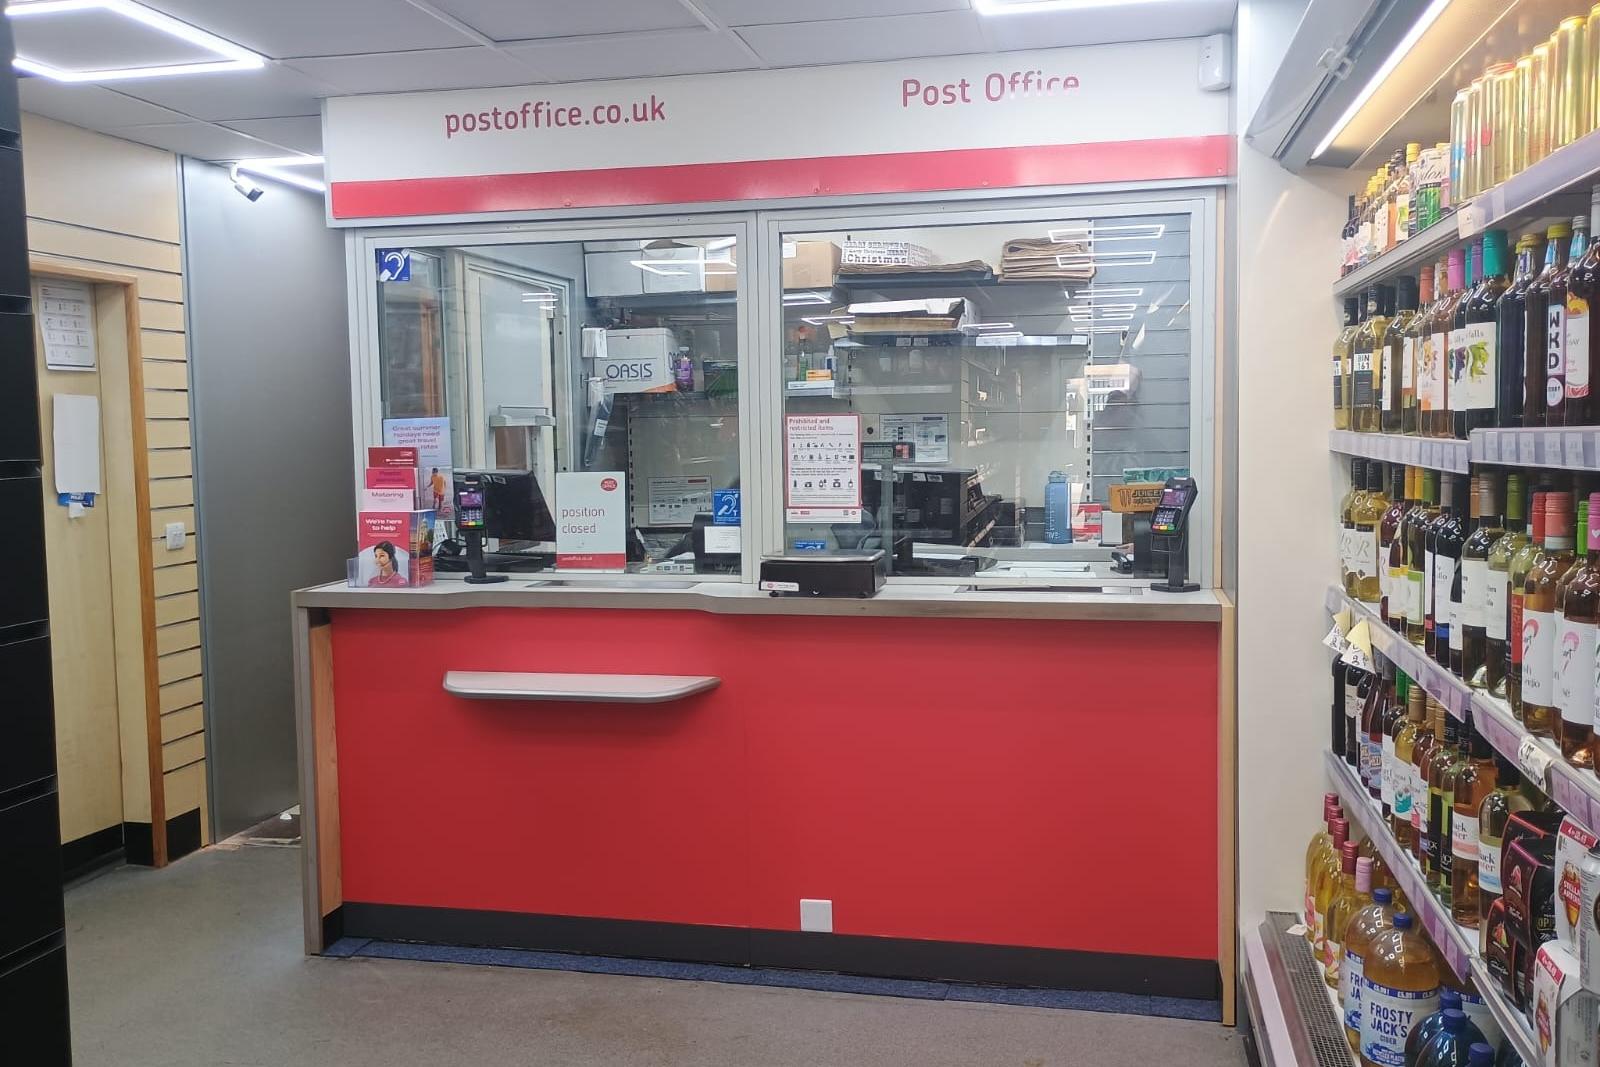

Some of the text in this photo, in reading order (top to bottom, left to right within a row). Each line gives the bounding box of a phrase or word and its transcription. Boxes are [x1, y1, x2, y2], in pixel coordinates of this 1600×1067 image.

[901, 69, 1081, 108] Post Office
[445, 94, 667, 139] postoffice.co.uk
[847, 253, 907, 264] Christmas
[1549, 311, 1561, 370] WKD
[606, 362, 653, 379] OASIS
[371, 491, 404, 499] Motoring
[562, 506, 605, 519] position
[562, 522, 596, 534] closed
[1370, 1001, 1414, 1025] FROSTY
[1370, 1018, 1408, 1038] JACK'S
[1379, 1034, 1397, 1045] CIDER
